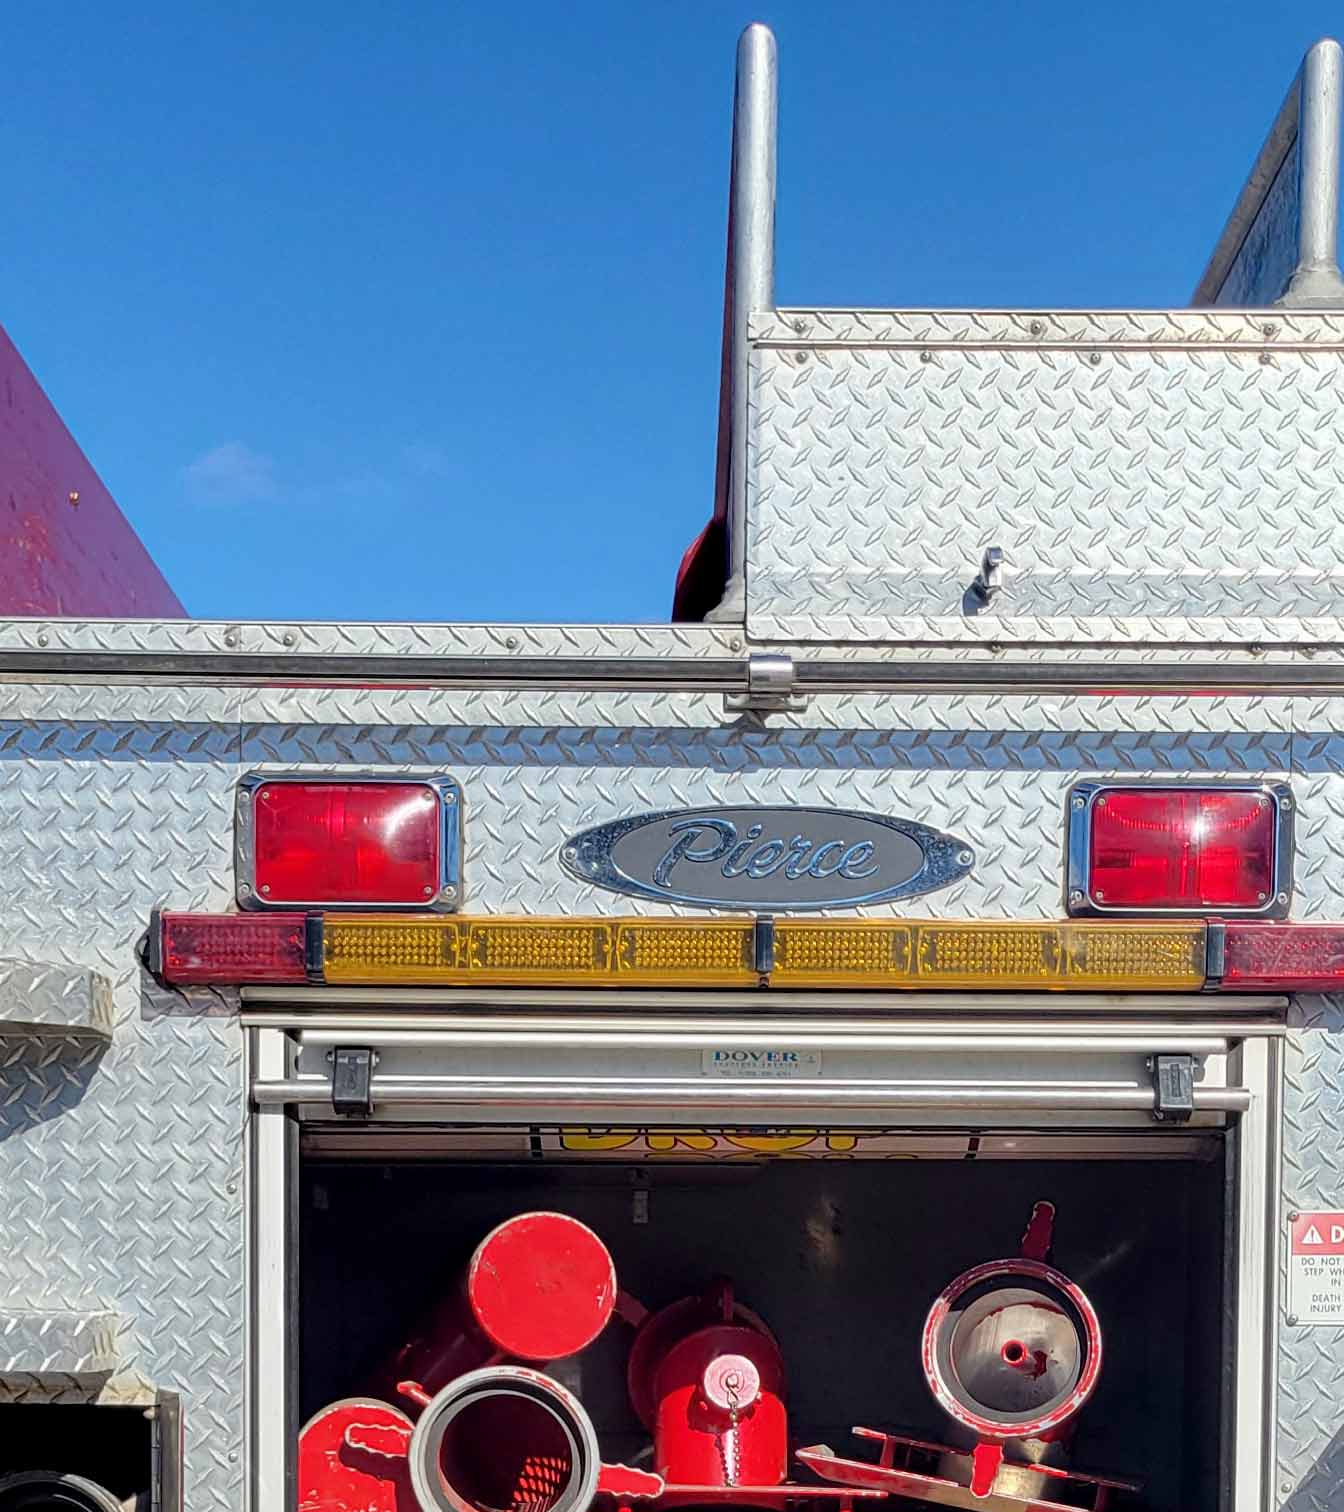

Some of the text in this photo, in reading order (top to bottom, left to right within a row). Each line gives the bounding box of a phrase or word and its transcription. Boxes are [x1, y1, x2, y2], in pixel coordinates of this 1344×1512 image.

[653, 817, 879, 888] Pierce
[713, 1050, 799, 1062] DOVER
[1301, 1257, 1315, 1266] DO
[1321, 1257, 1341, 1266] NOT
[1304, 1267, 1324, 1276] STEP
[1331, 1278, 1341, 1287] IN
[1312, 1294, 1341, 1303] DEATH
[1310, 1304, 1341, 1313] INJURY
